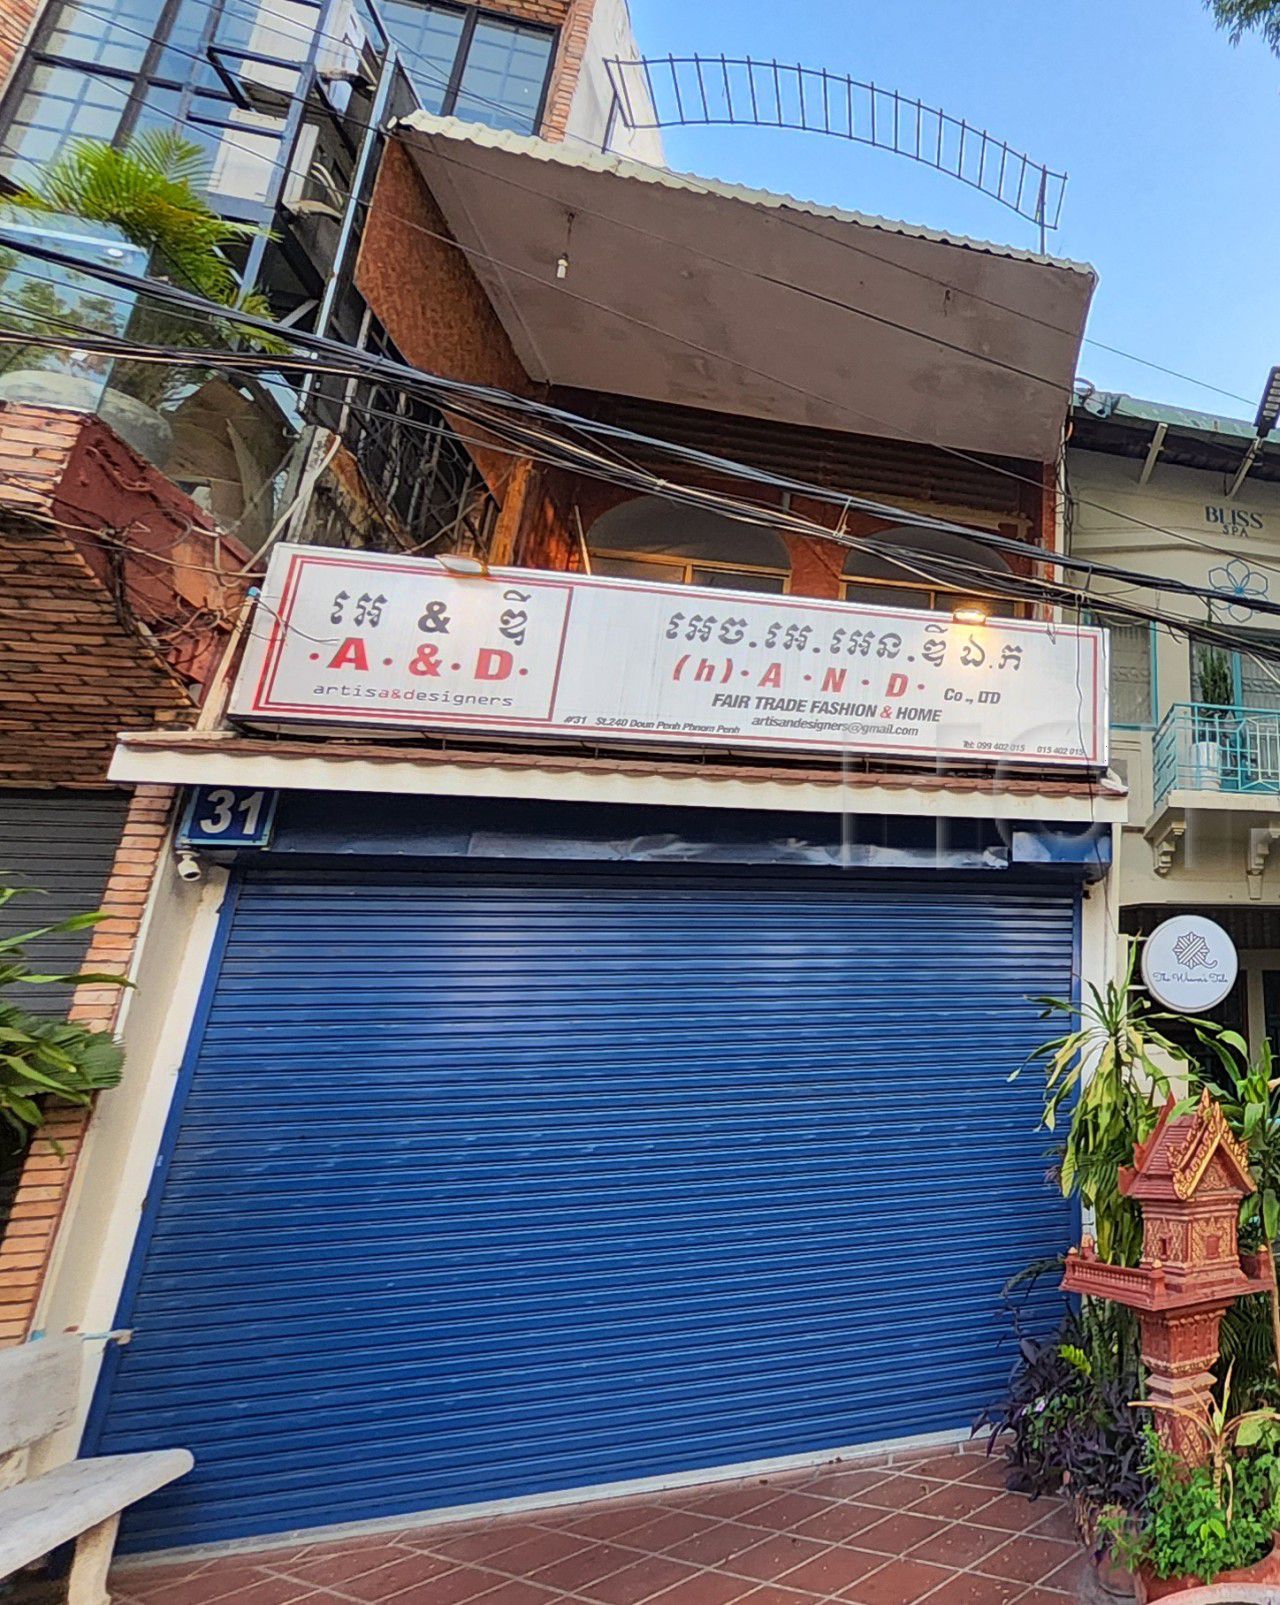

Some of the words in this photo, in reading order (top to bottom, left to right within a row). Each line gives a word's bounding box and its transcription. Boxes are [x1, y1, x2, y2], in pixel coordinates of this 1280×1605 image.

[1205, 506, 1263, 529] BLISS
[1222, 525, 1249, 538] SPA
[711, 693, 751, 709] FAIR
[755, 696, 808, 713] TRADE
[809, 700, 877, 718] FASHION
[879, 705, 892, 720] &
[896, 707, 942, 722] HOME
[977, 690, 1001, 705] LTD
[656, 721, 681, 731] Penh
[716, 724, 740, 734] Penh
[751, 716, 919, 736] artisandesigners@gmail.com
[200, 789, 265, 835] 31
